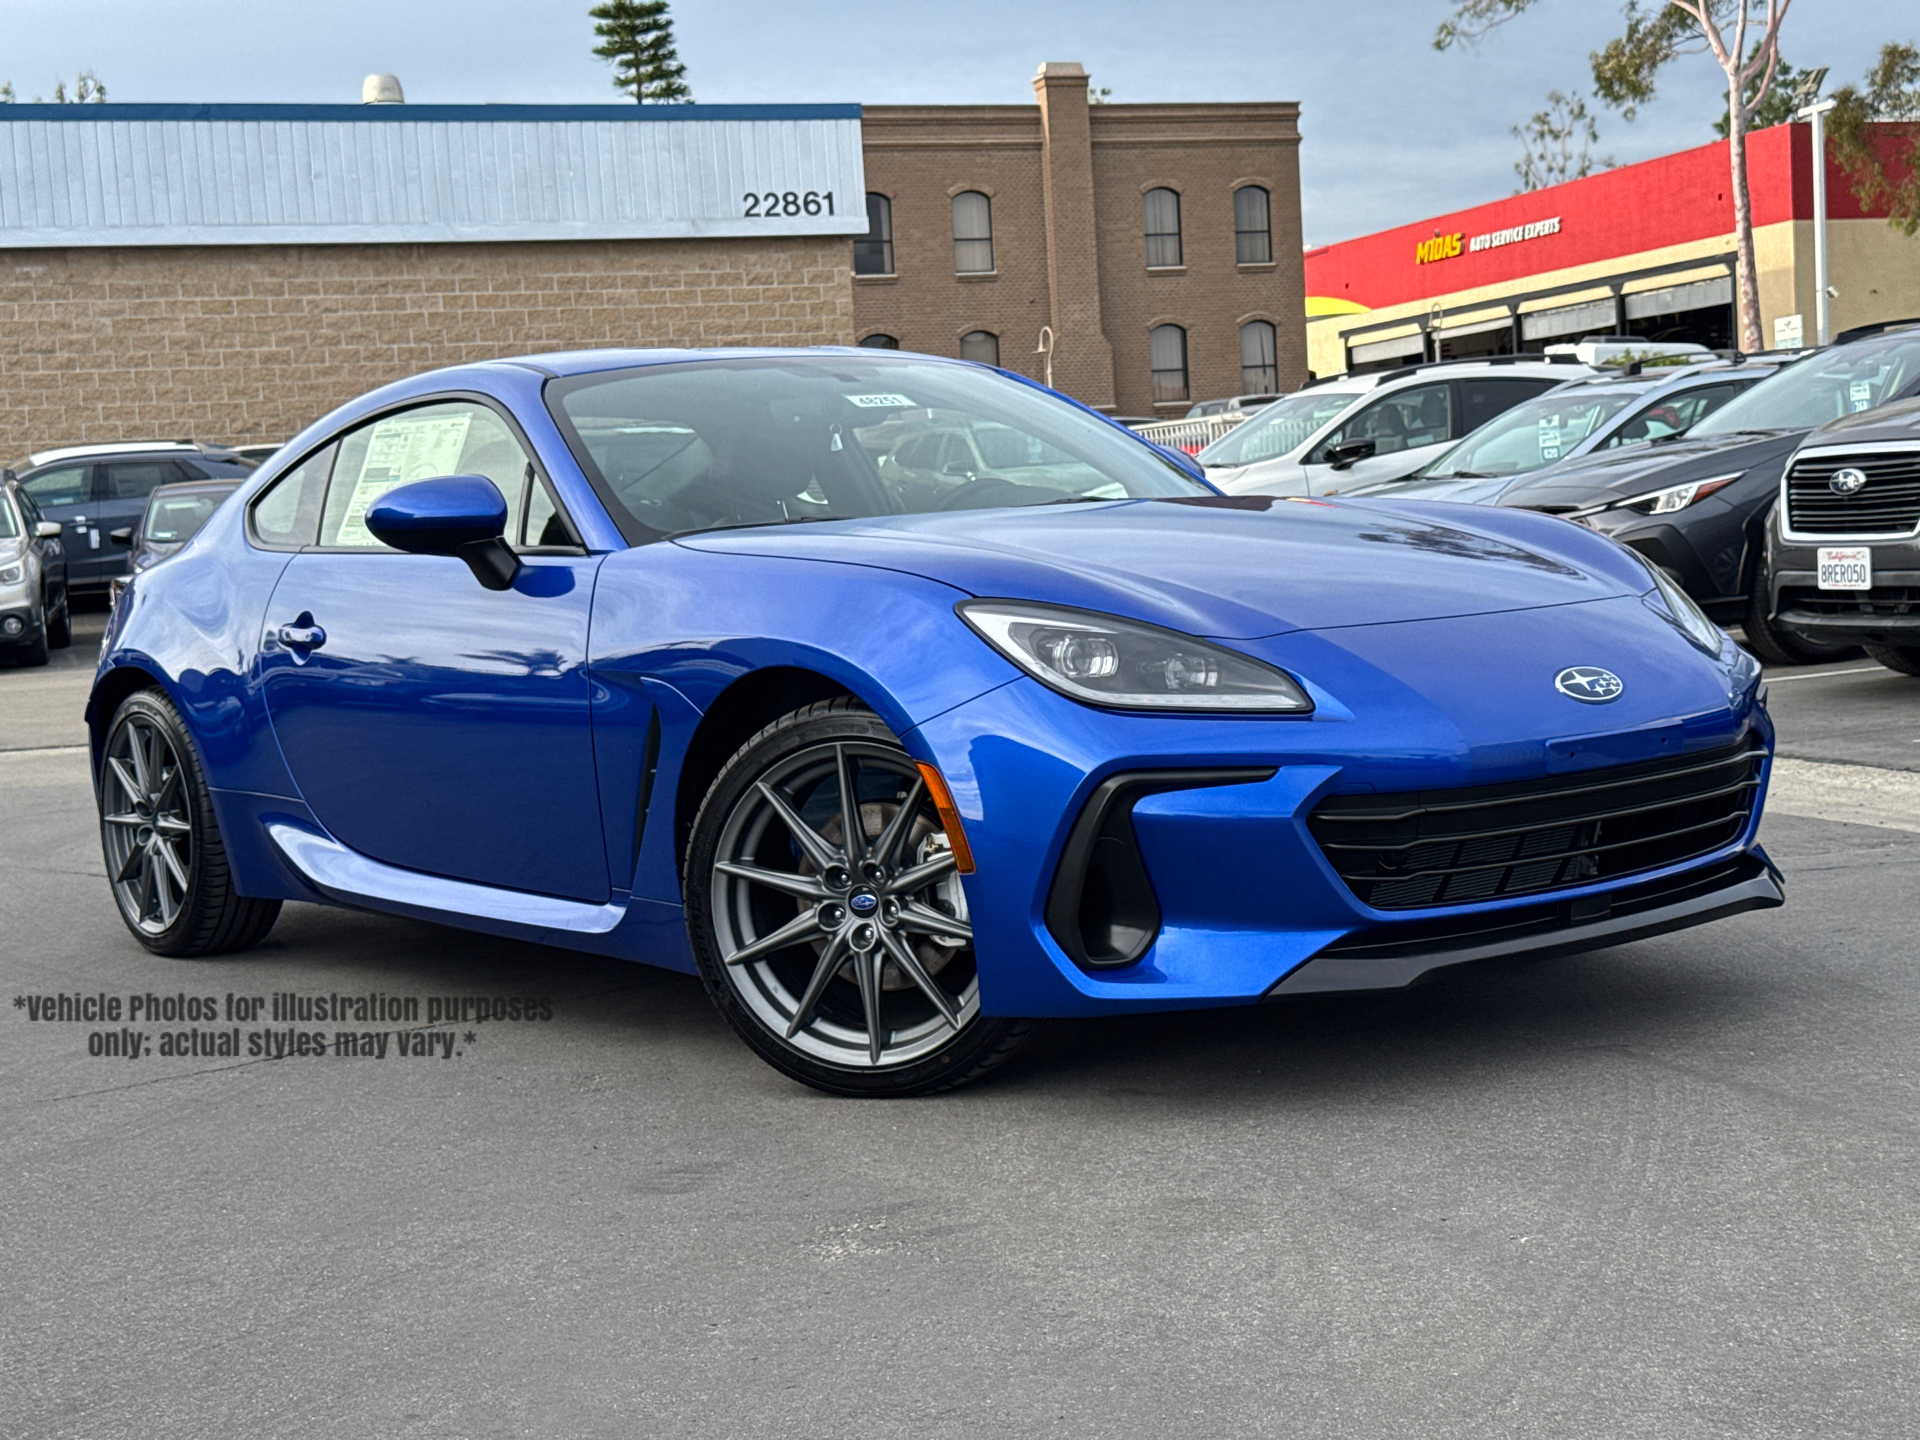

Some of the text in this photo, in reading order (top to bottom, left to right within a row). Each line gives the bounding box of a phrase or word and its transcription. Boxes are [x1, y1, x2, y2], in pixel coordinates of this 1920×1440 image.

[743, 191, 834, 217] 22861
[1416, 216, 1562, 264] MIDAS AUTO SERVICE EXPERTS
[1821, 563, 1866, 583] 8RER050
